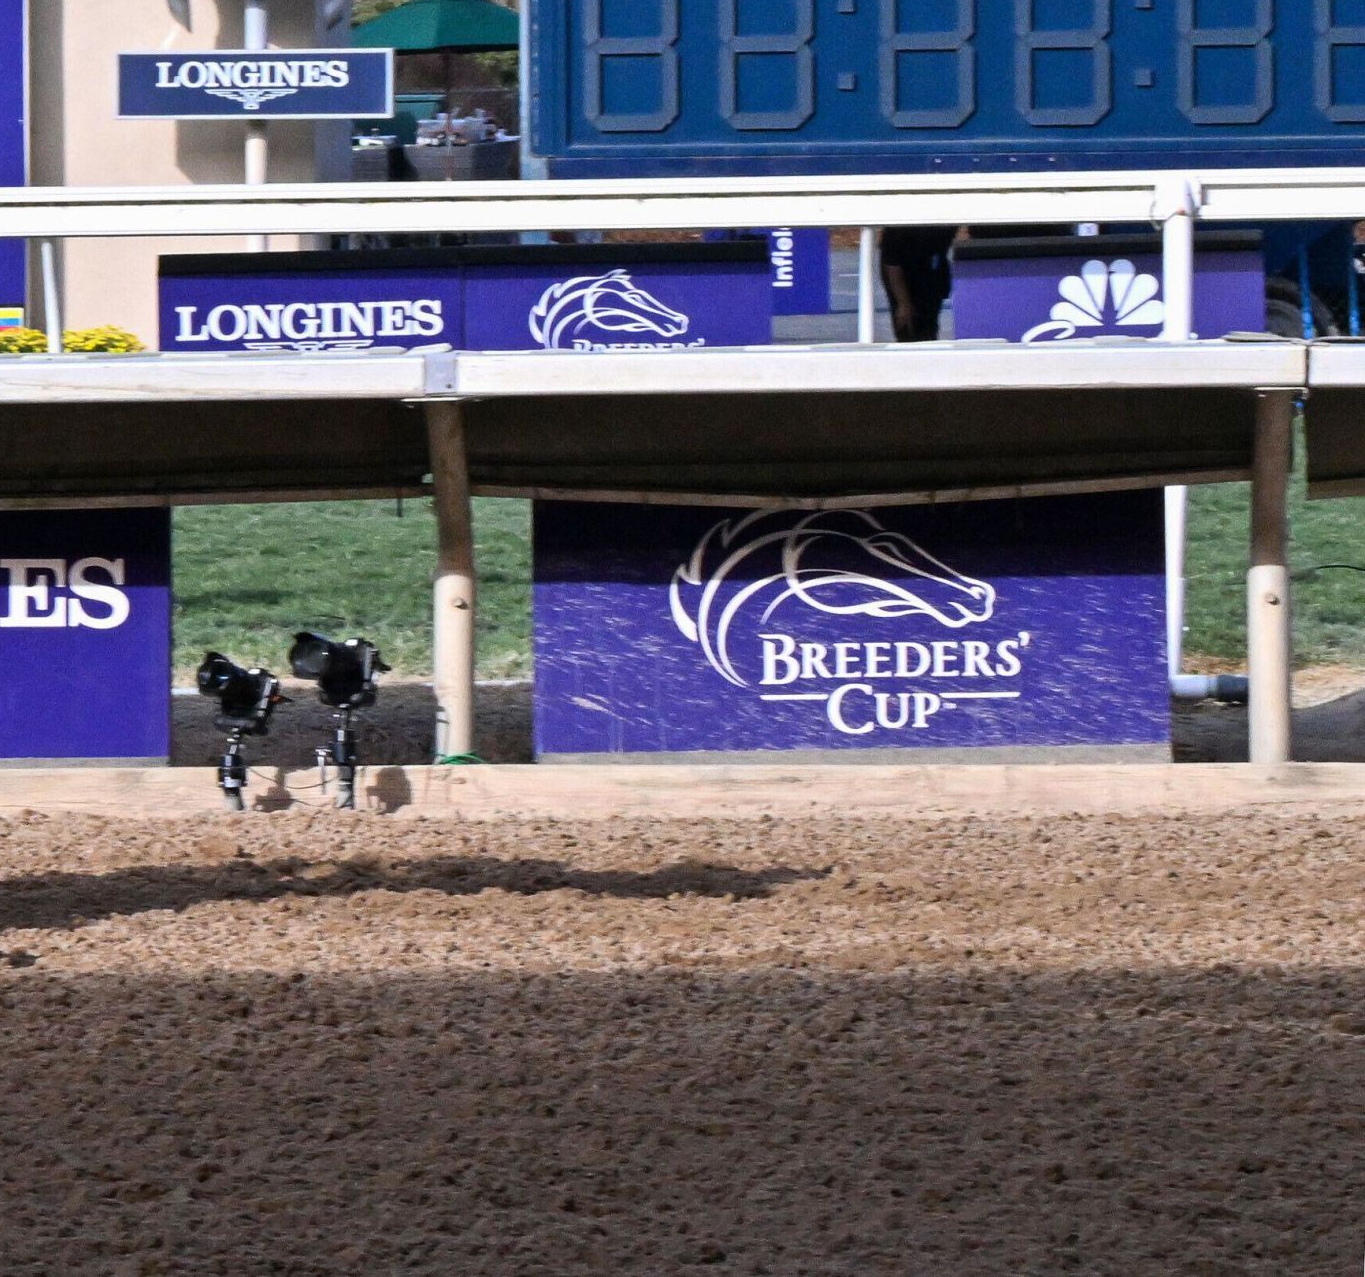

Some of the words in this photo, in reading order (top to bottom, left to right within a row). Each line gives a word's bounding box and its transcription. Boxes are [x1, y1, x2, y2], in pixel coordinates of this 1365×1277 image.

[155, 59, 350, 90] LONGINES
[174, 299, 445, 342] LONGINES
[759, 630, 1030, 686] BREEDERS'
[825, 682, 943, 735] CUP
